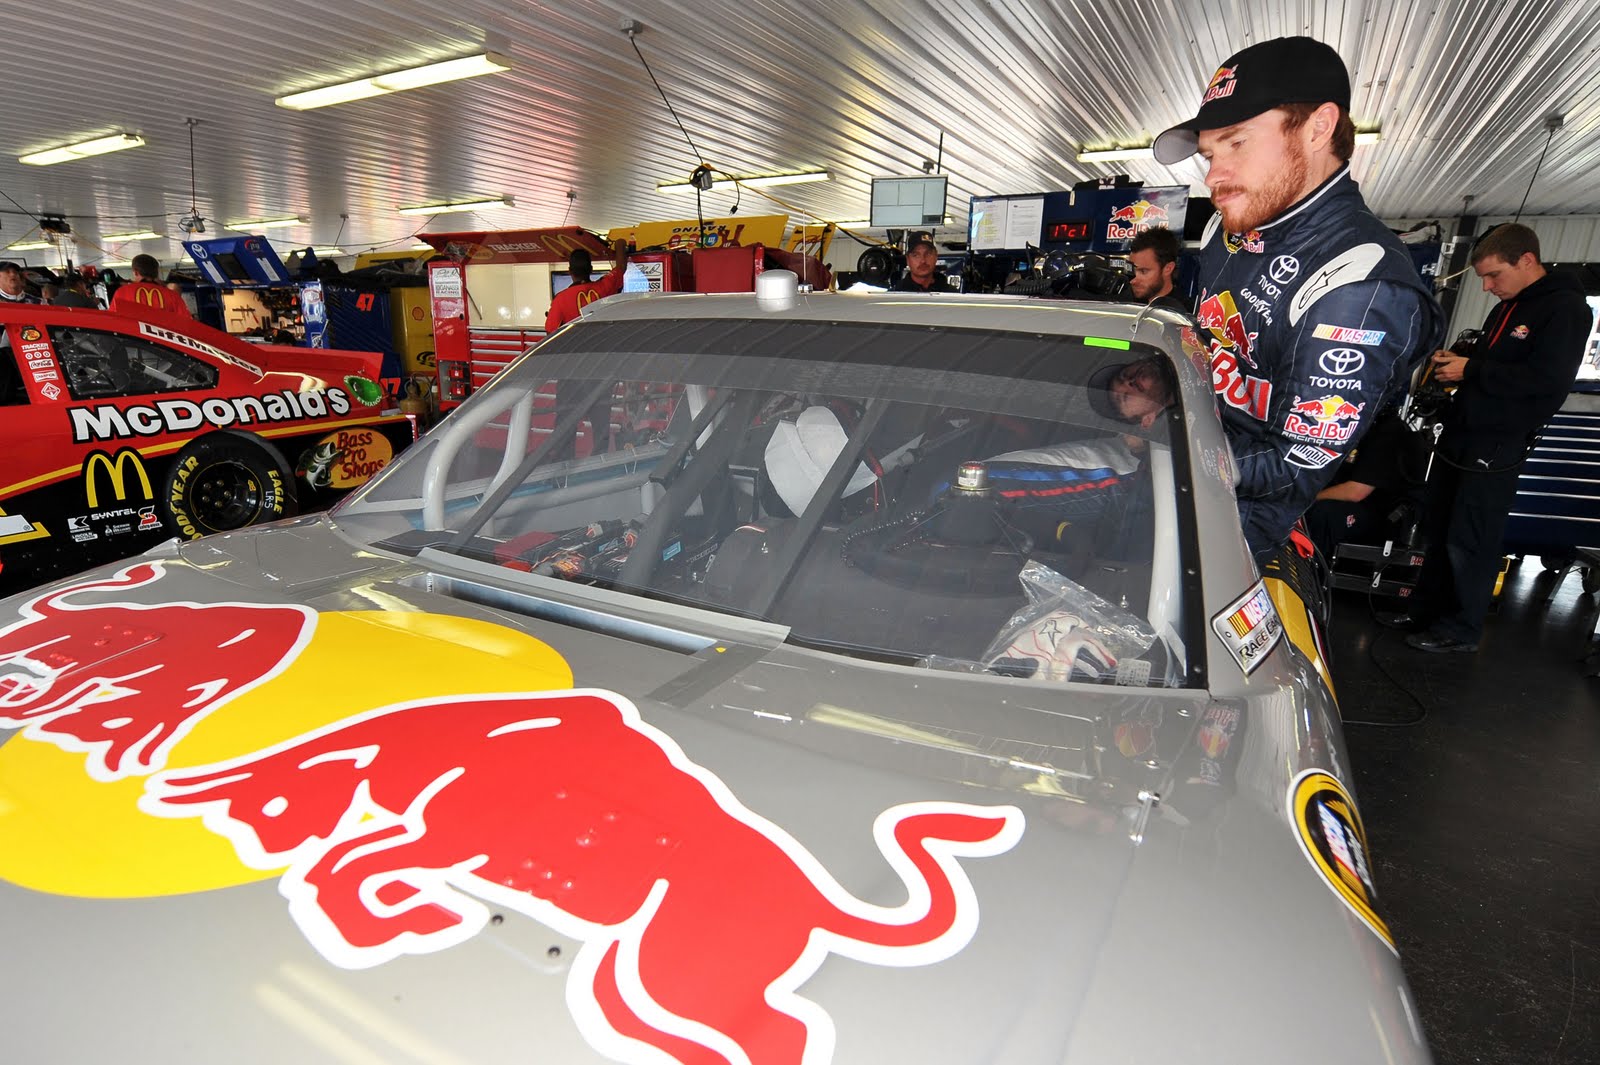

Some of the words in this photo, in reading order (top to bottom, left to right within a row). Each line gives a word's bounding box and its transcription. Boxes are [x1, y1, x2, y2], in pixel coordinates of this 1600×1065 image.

[1107, 224, 1137, 239] Red
[356, 293, 375, 311] 47
[1340, 329, 1384, 345] NASCAR
[1309, 376, 1362, 391] TOYOTA
[71, 387, 350, 441] McDonald's
[1284, 413, 1325, 438] Red
[1325, 420, 1358, 439] Bull
[337, 431, 373, 449] Bass
[340, 447, 366, 464] Pro
[340, 459, 385, 481] Shops
[267, 469, 284, 514] EAGLE
[91, 508, 136, 521] SYNTEL
